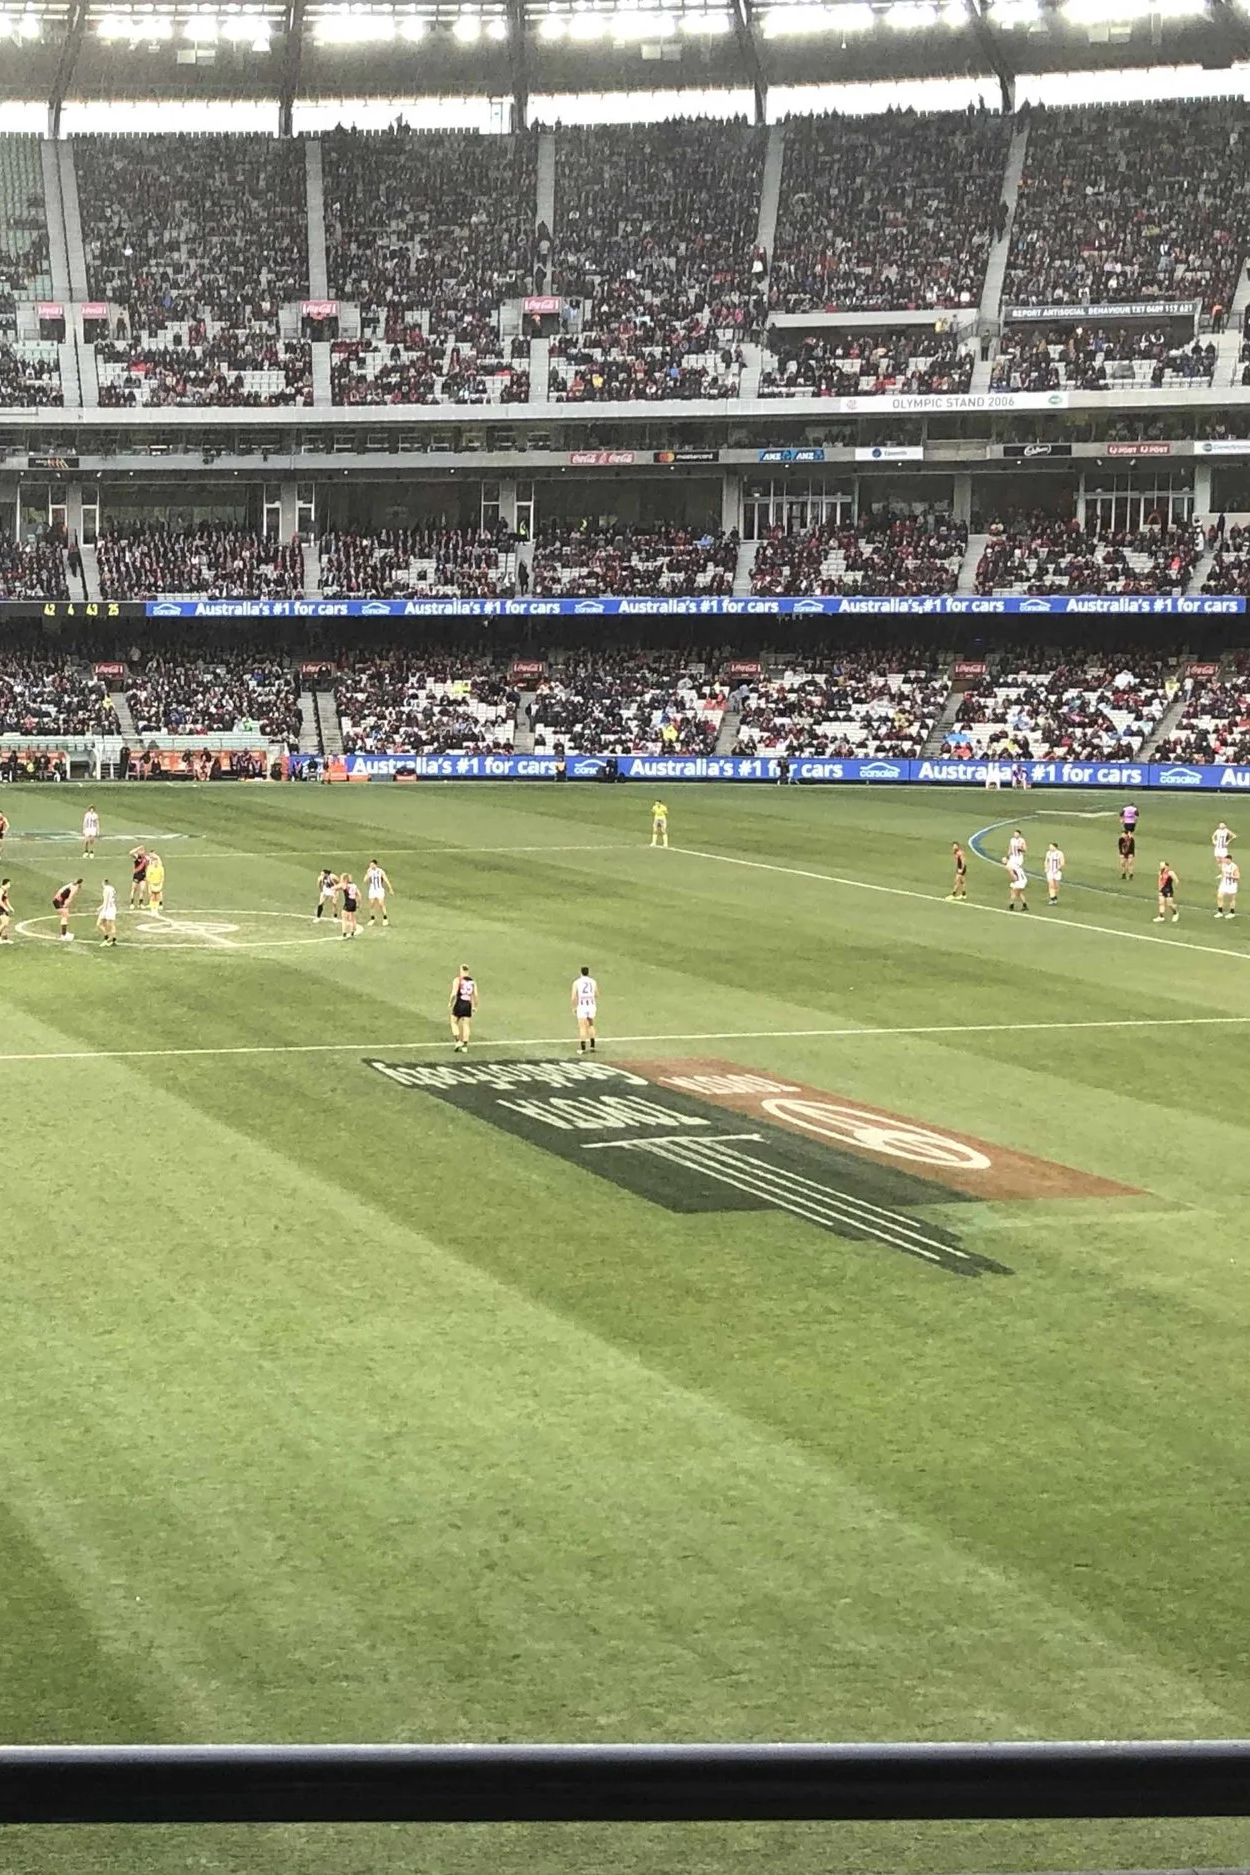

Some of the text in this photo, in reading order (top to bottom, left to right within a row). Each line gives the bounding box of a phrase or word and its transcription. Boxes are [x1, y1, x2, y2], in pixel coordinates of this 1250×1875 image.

[892, 396, 1015, 409] OLYMPIC STAND 2006
[762, 452, 781, 460] ANZ
[796, 451, 815, 460] ANZ
[195, 601, 348, 615] Australia's #1 for cars
[404, 601, 560, 615] Australia's #1 for cars
[618, 599, 779, 613] Australia's #1 for cars
[839, 599, 1005, 613] Australia's #1 for cars
[1066, 598, 1238, 612] Australia's #1 for cars
[456, 757, 480, 774] #1
[484, 756, 513, 774] for
[630, 758, 844, 778] Australia's #1 fr cars
[1031, 762, 1056, 781] #1
[1062, 763, 1094, 782] for
[1097, 767, 1142, 784] cars
[497, 1095, 711, 1129] TOYOTA
